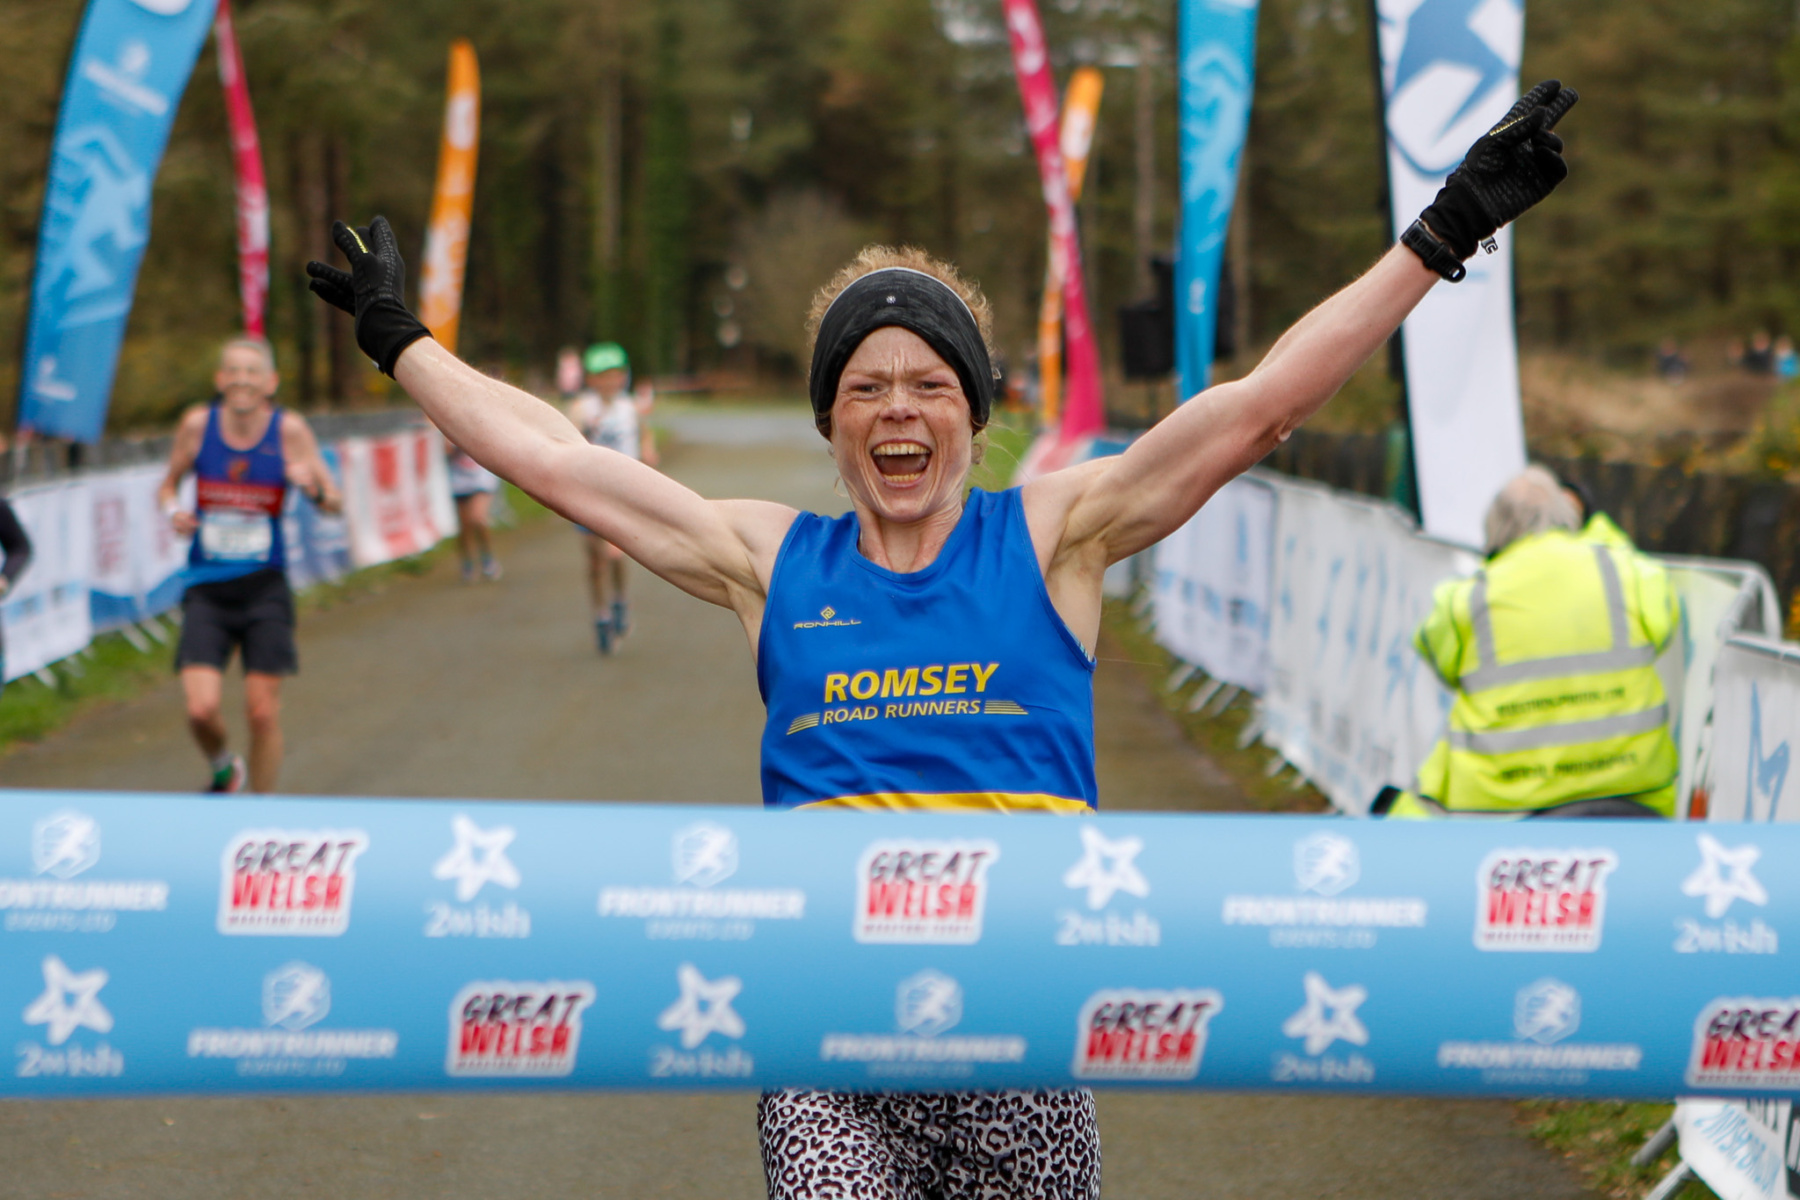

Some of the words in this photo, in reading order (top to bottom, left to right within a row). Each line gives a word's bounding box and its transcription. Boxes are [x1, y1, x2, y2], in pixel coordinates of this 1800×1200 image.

[793, 619, 862, 630] RONHILL
[824, 662, 1000, 703] ROMSEY
[823, 706, 879, 725] ROAD
[885, 700, 981, 719] RUNNERS
[234, 841, 355, 873] GREAT
[869, 851, 989, 882] GREAT
[232, 872, 345, 910] WELSH
[1490, 859, 1607, 893] GREAT
[598, 887, 807, 919] FRONTRUNNER
[867, 880, 978, 918] WELSH
[1222, 895, 1429, 928] FRONTRUNNER
[1487, 889, 1596, 927] WELSH
[463, 994, 584, 1026] GREAT
[1093, 1002, 1212, 1032] GREAT
[188, 1028, 398, 1058] FRONTRUNNER
[460, 1023, 573, 1057] WELSH
[821, 1033, 1027, 1063] FRONTRUNNER
[1087, 1029, 1198, 1063] WELSH
[1437, 1041, 1642, 1071] FRONTRUNNER
